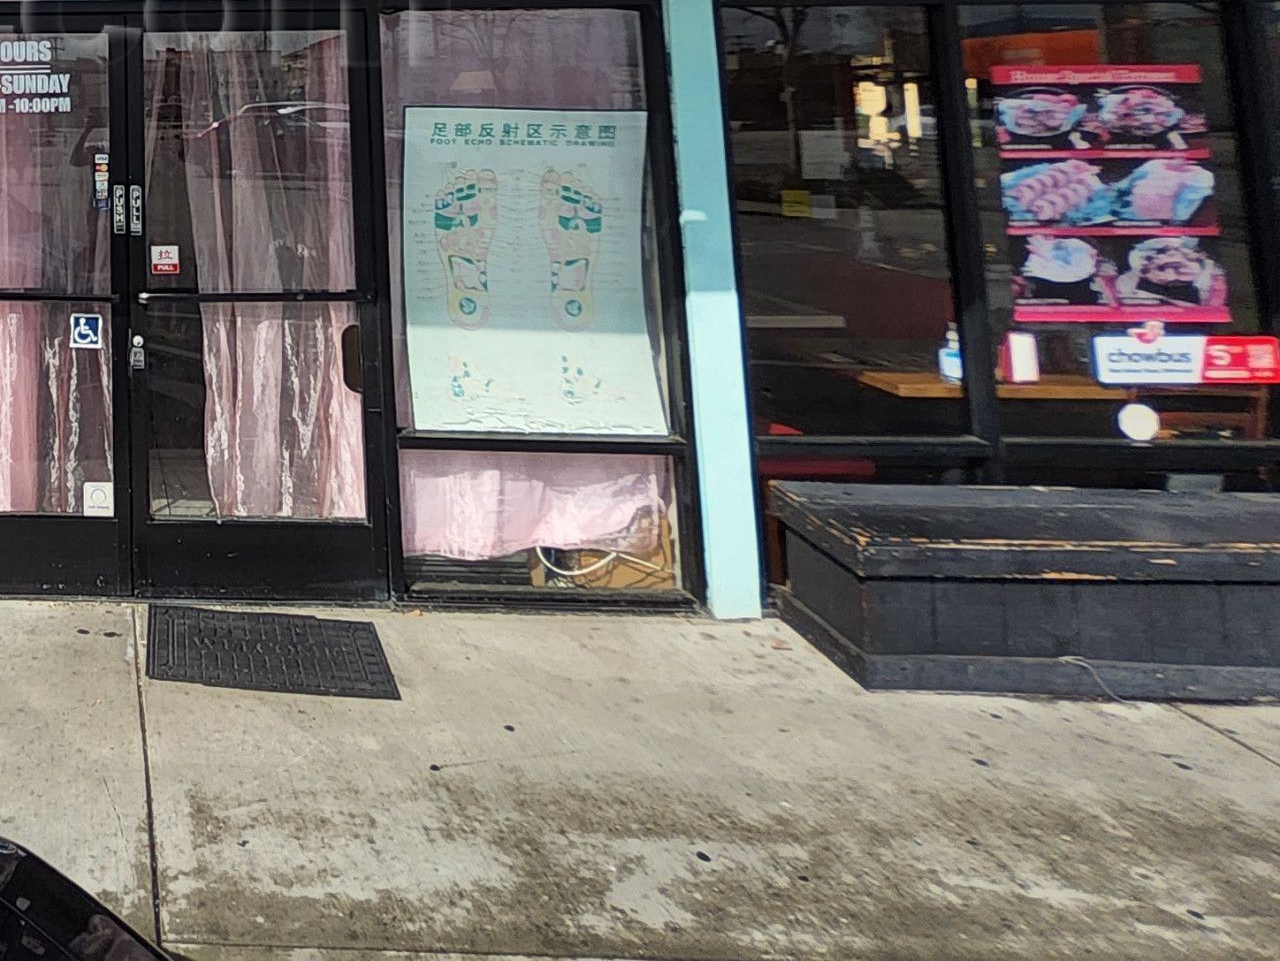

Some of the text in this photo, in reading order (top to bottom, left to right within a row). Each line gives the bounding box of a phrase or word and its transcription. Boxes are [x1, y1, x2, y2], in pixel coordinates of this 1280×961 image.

[431, 122, 617, 140] 足部反射区示意图
[430, 138, 457, 146] FOOT
[464, 138, 492, 146] ECHO
[499, 139, 558, 147] SCHEMATIC
[115, 189, 124, 222] PUSH
[133, 190, 141, 224] PULL
[1108, 347, 1192, 364] chowbus
